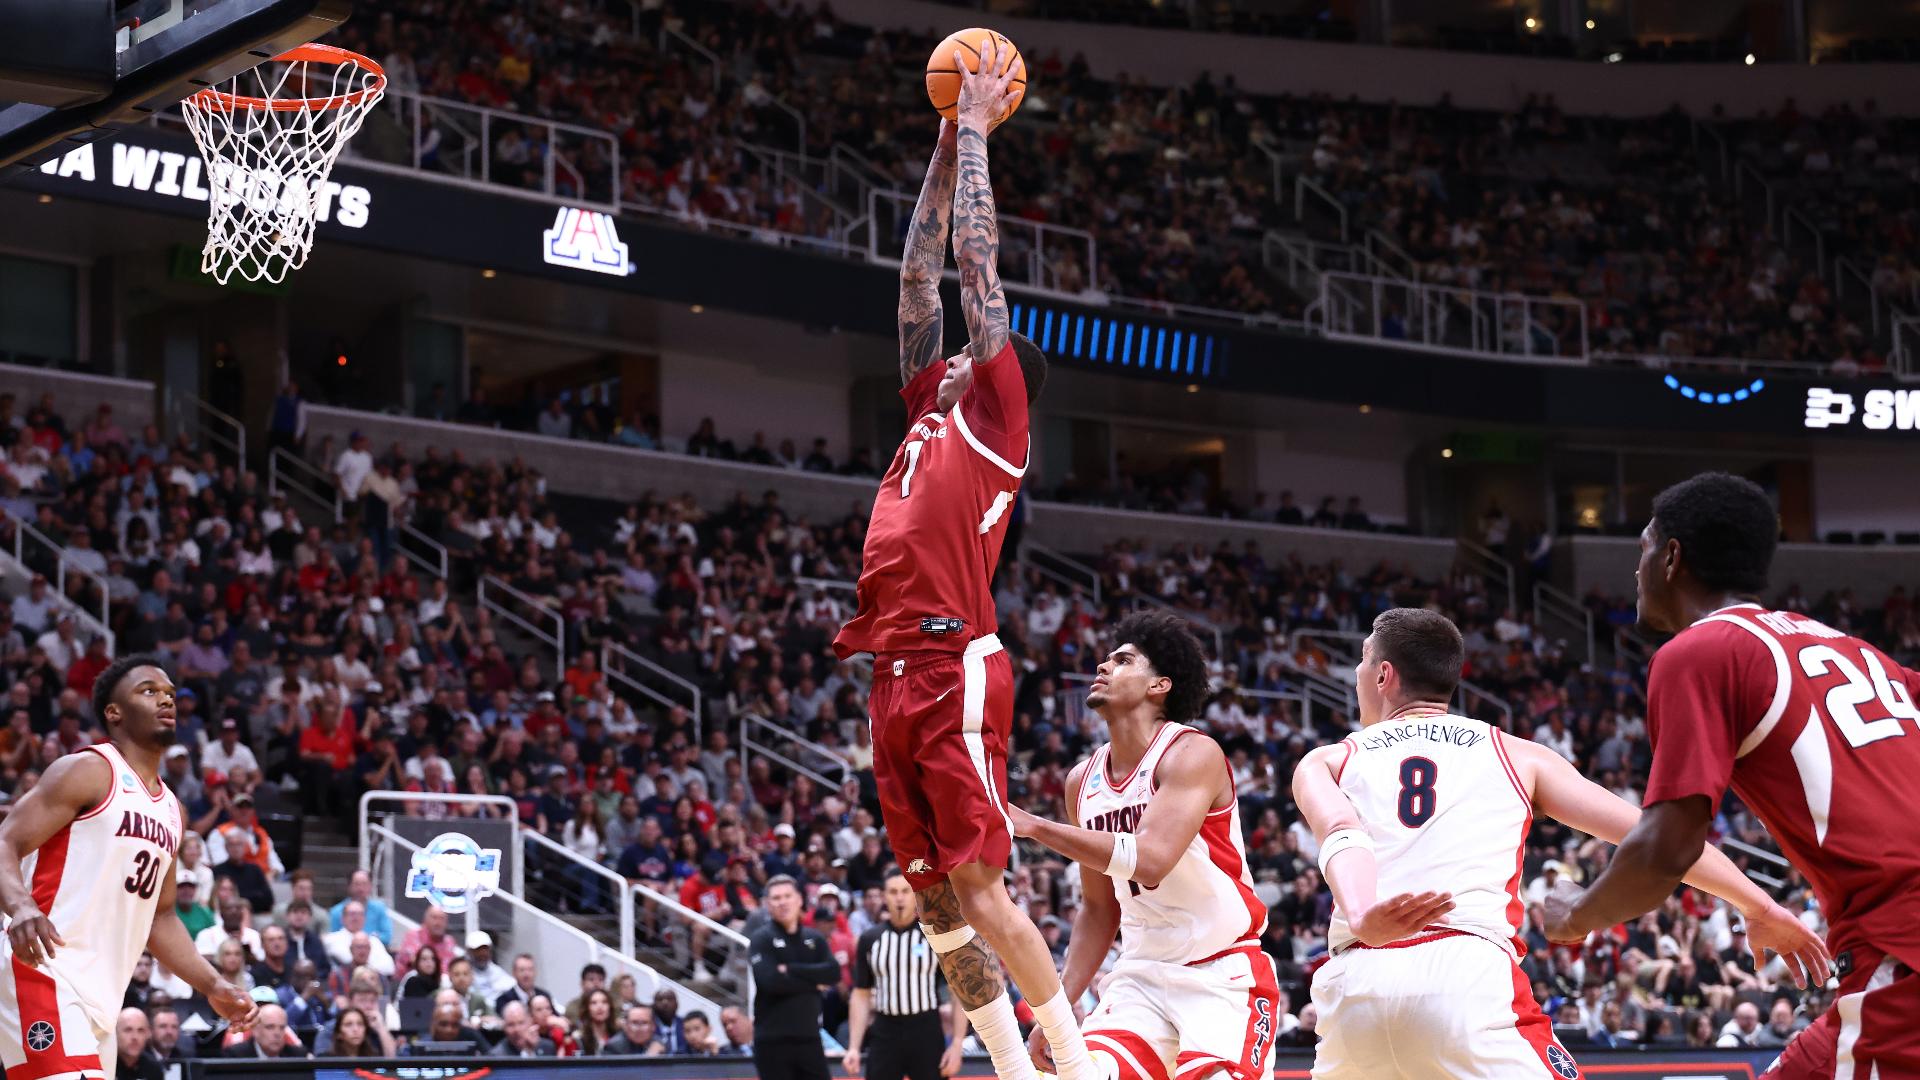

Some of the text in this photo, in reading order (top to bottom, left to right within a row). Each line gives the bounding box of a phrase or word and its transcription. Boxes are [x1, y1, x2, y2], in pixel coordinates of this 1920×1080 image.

[112, 143, 371, 229] WILDCATS
[1798, 644, 1920, 749] 24
[1397, 755, 1438, 829] 8
[124, 849, 161, 900] 30
[1252, 997, 1271, 1068] CATS
